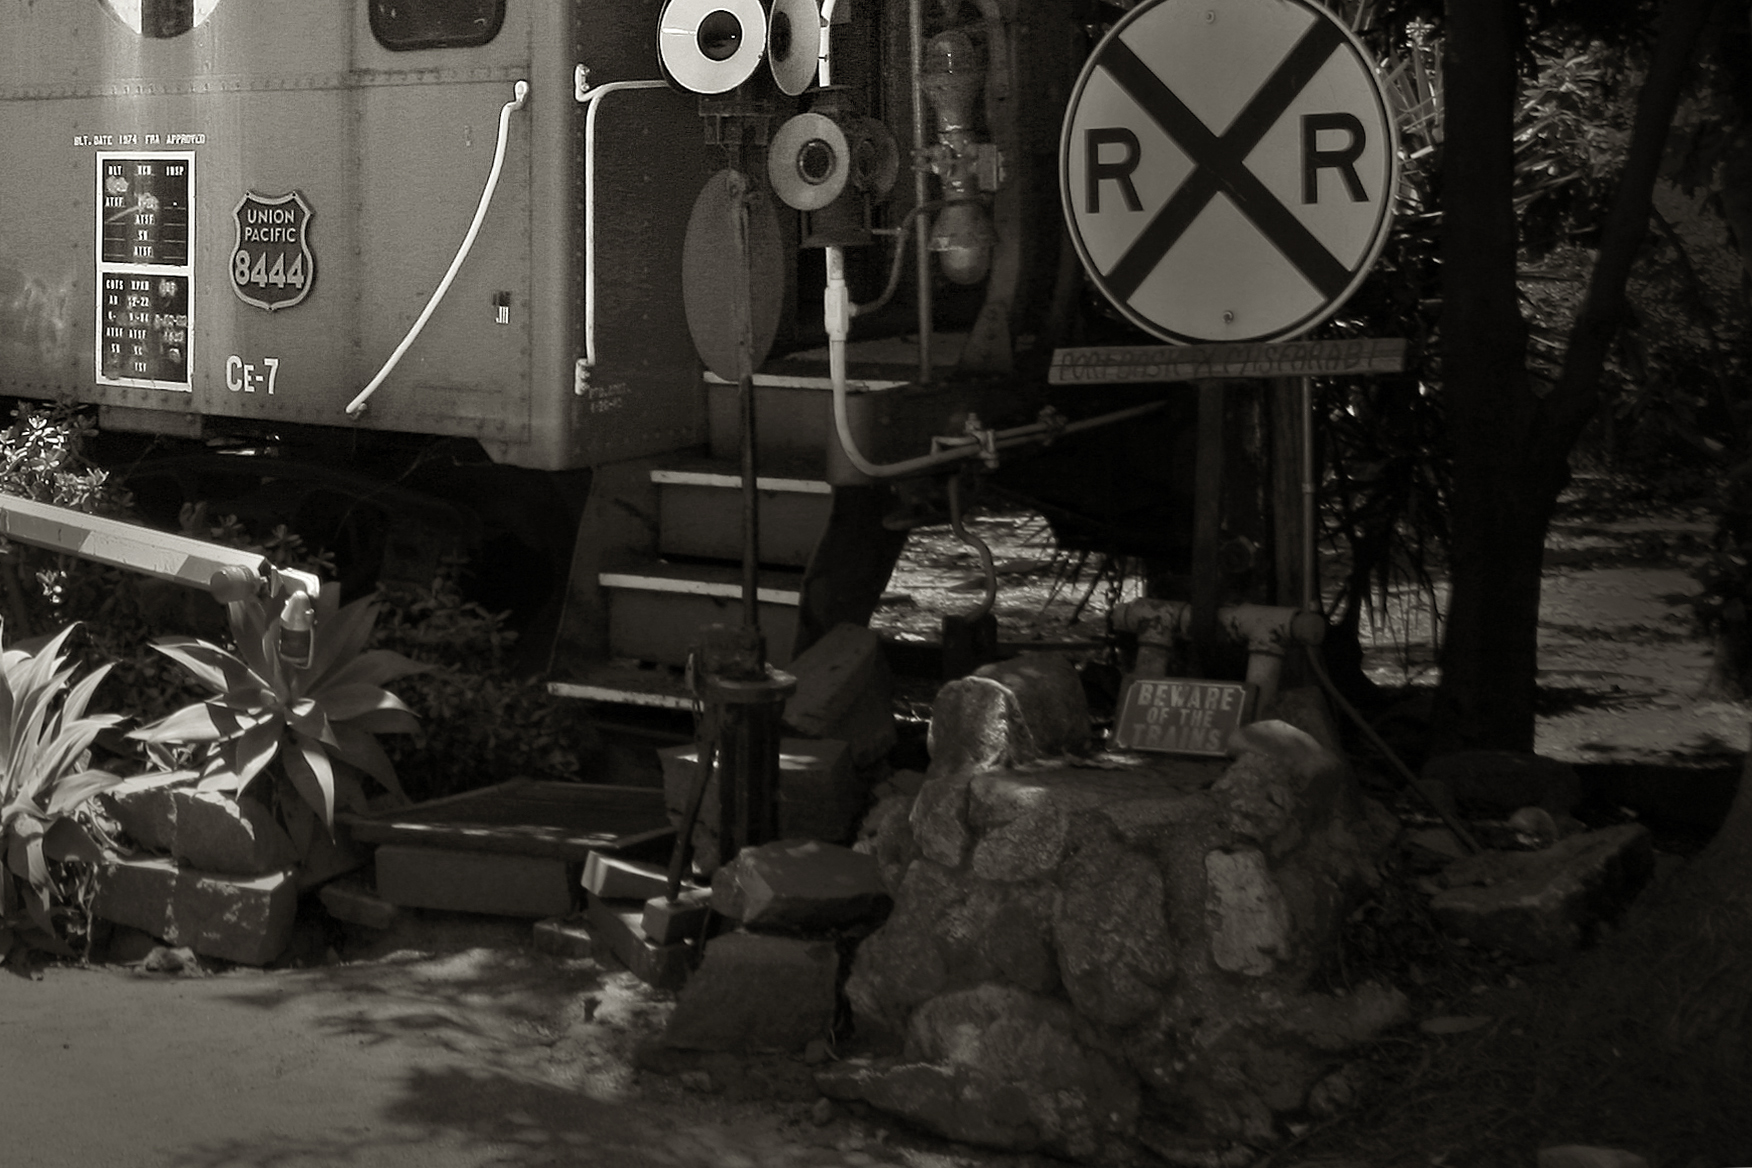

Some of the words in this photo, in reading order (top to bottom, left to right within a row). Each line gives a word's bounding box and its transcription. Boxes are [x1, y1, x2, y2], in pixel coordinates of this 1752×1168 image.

[165, 133, 206, 145] APPROVED
[1083, 126, 1145, 215] R
[1299, 111, 1370, 205] R
[247, 208, 295, 225] UNION
[244, 226, 297, 244] PACIFIC
[234, 249, 305, 290] 8444
[1136, 683, 1235, 711] BEWARE
[1147, 706, 1170, 725] OF
[1179, 707, 1215, 728] THE
[1131, 722, 1221, 751] TRAINS
